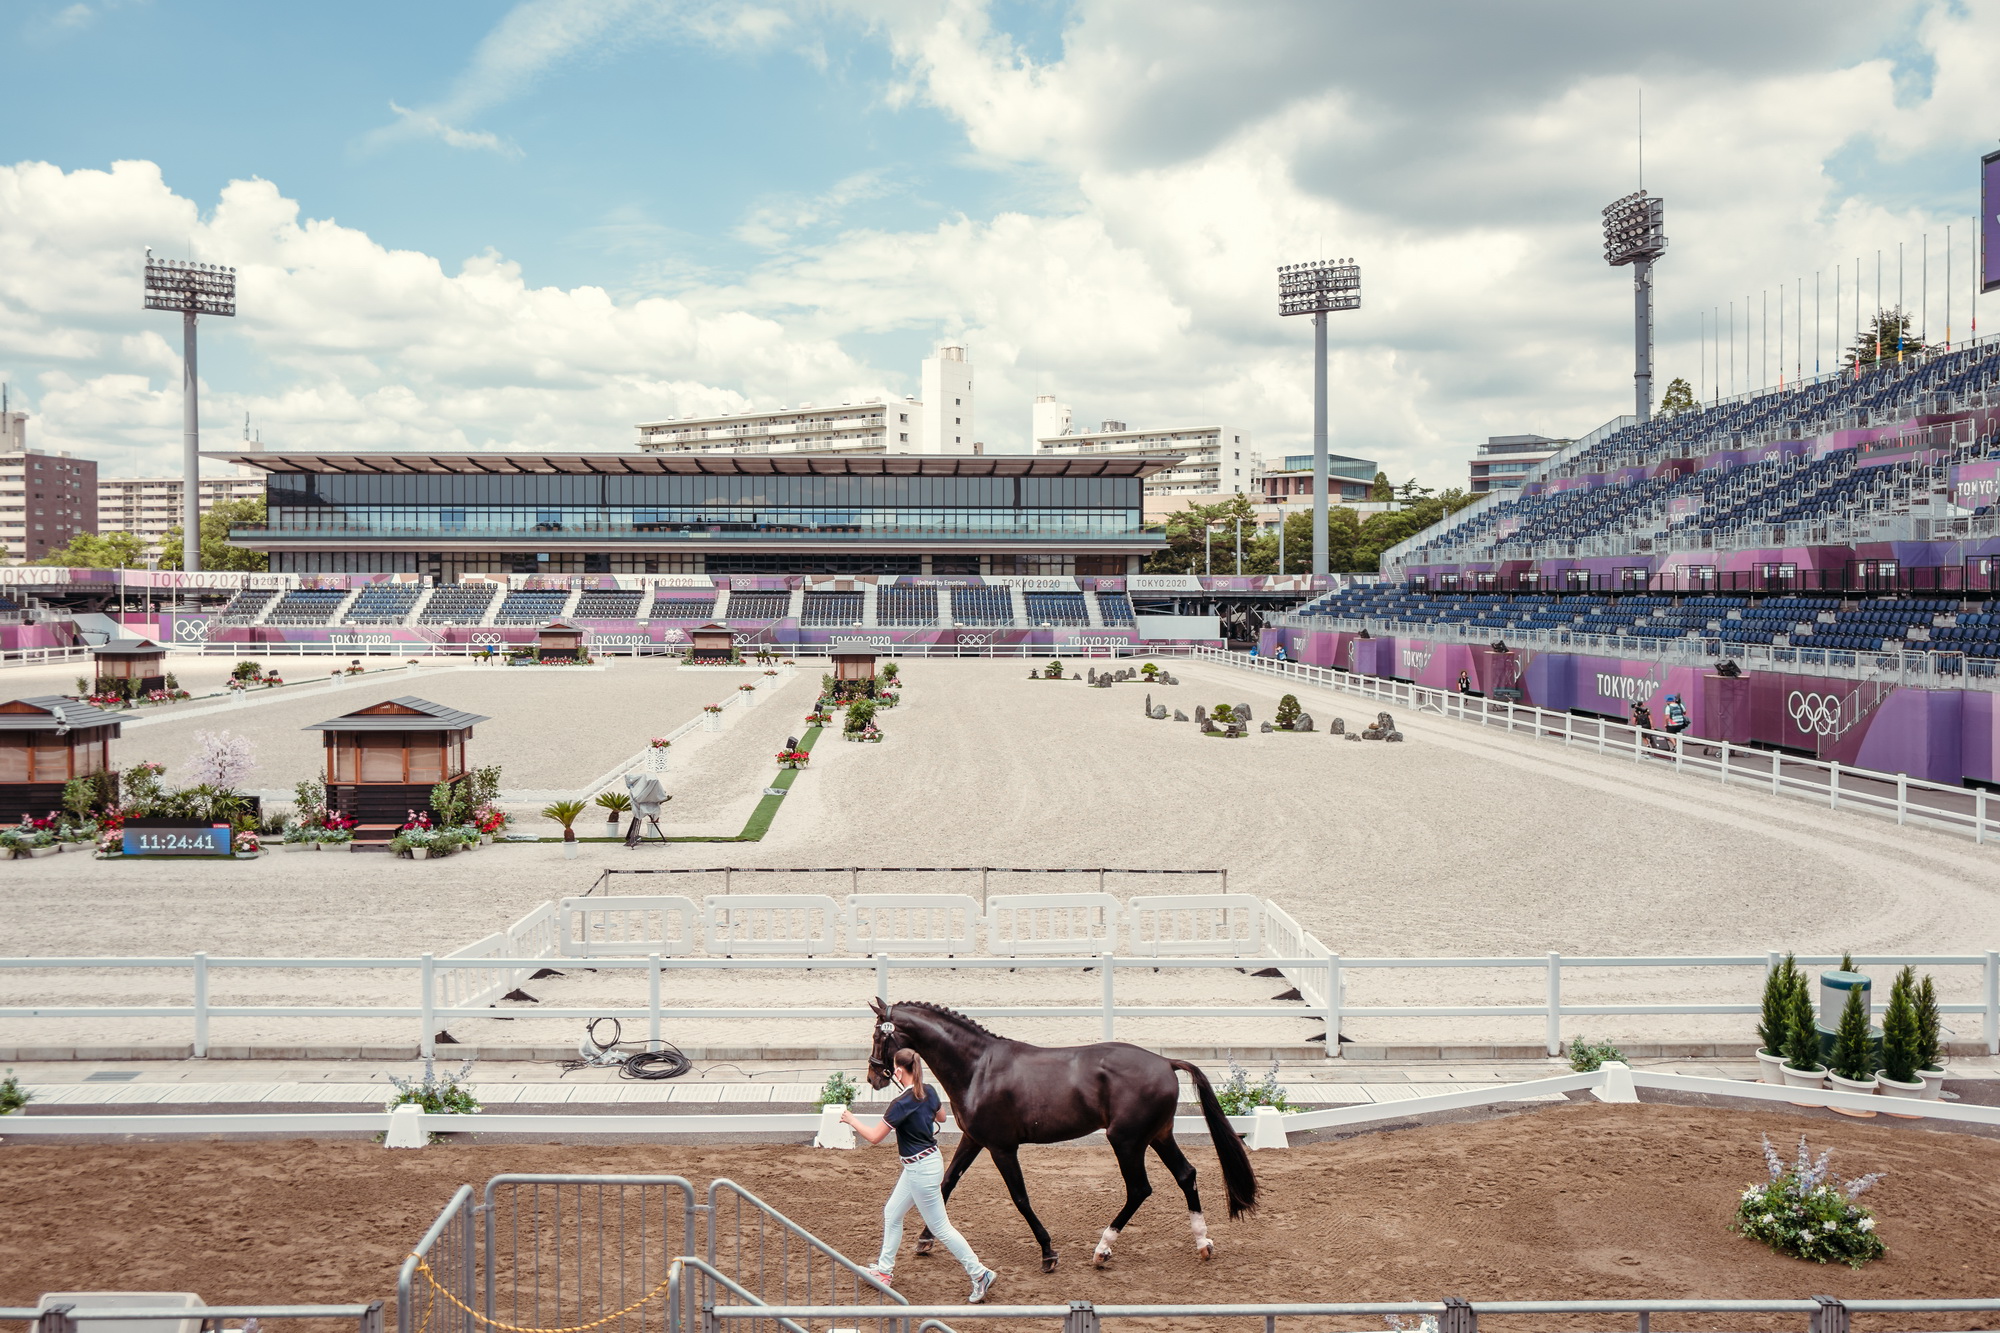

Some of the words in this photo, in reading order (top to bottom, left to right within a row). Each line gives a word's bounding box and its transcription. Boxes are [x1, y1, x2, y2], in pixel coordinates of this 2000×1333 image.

[0, 569, 51, 585] OKYO
[151, 573, 205, 588] TOKYO
[209, 574, 249, 589] 2020
[669, 578, 694, 587] 2020
[936, 579, 944, 587] by
[1036, 579, 1060, 588] 2020
[1136, 579, 1164, 588] TOKYO
[1166, 579, 1187, 588] 2020
[329, 634, 364, 644] TOKYO
[365, 634, 391, 644] 2020
[625, 635, 650, 645] 2020
[865, 635, 891, 645] 2020
[1068, 636, 1102, 646] TOKYO
[1103, 636, 1128, 646] 2020
[1596, 673, 1635, 700] TOKYO
[140, 834, 215, 850] 11:24:41
